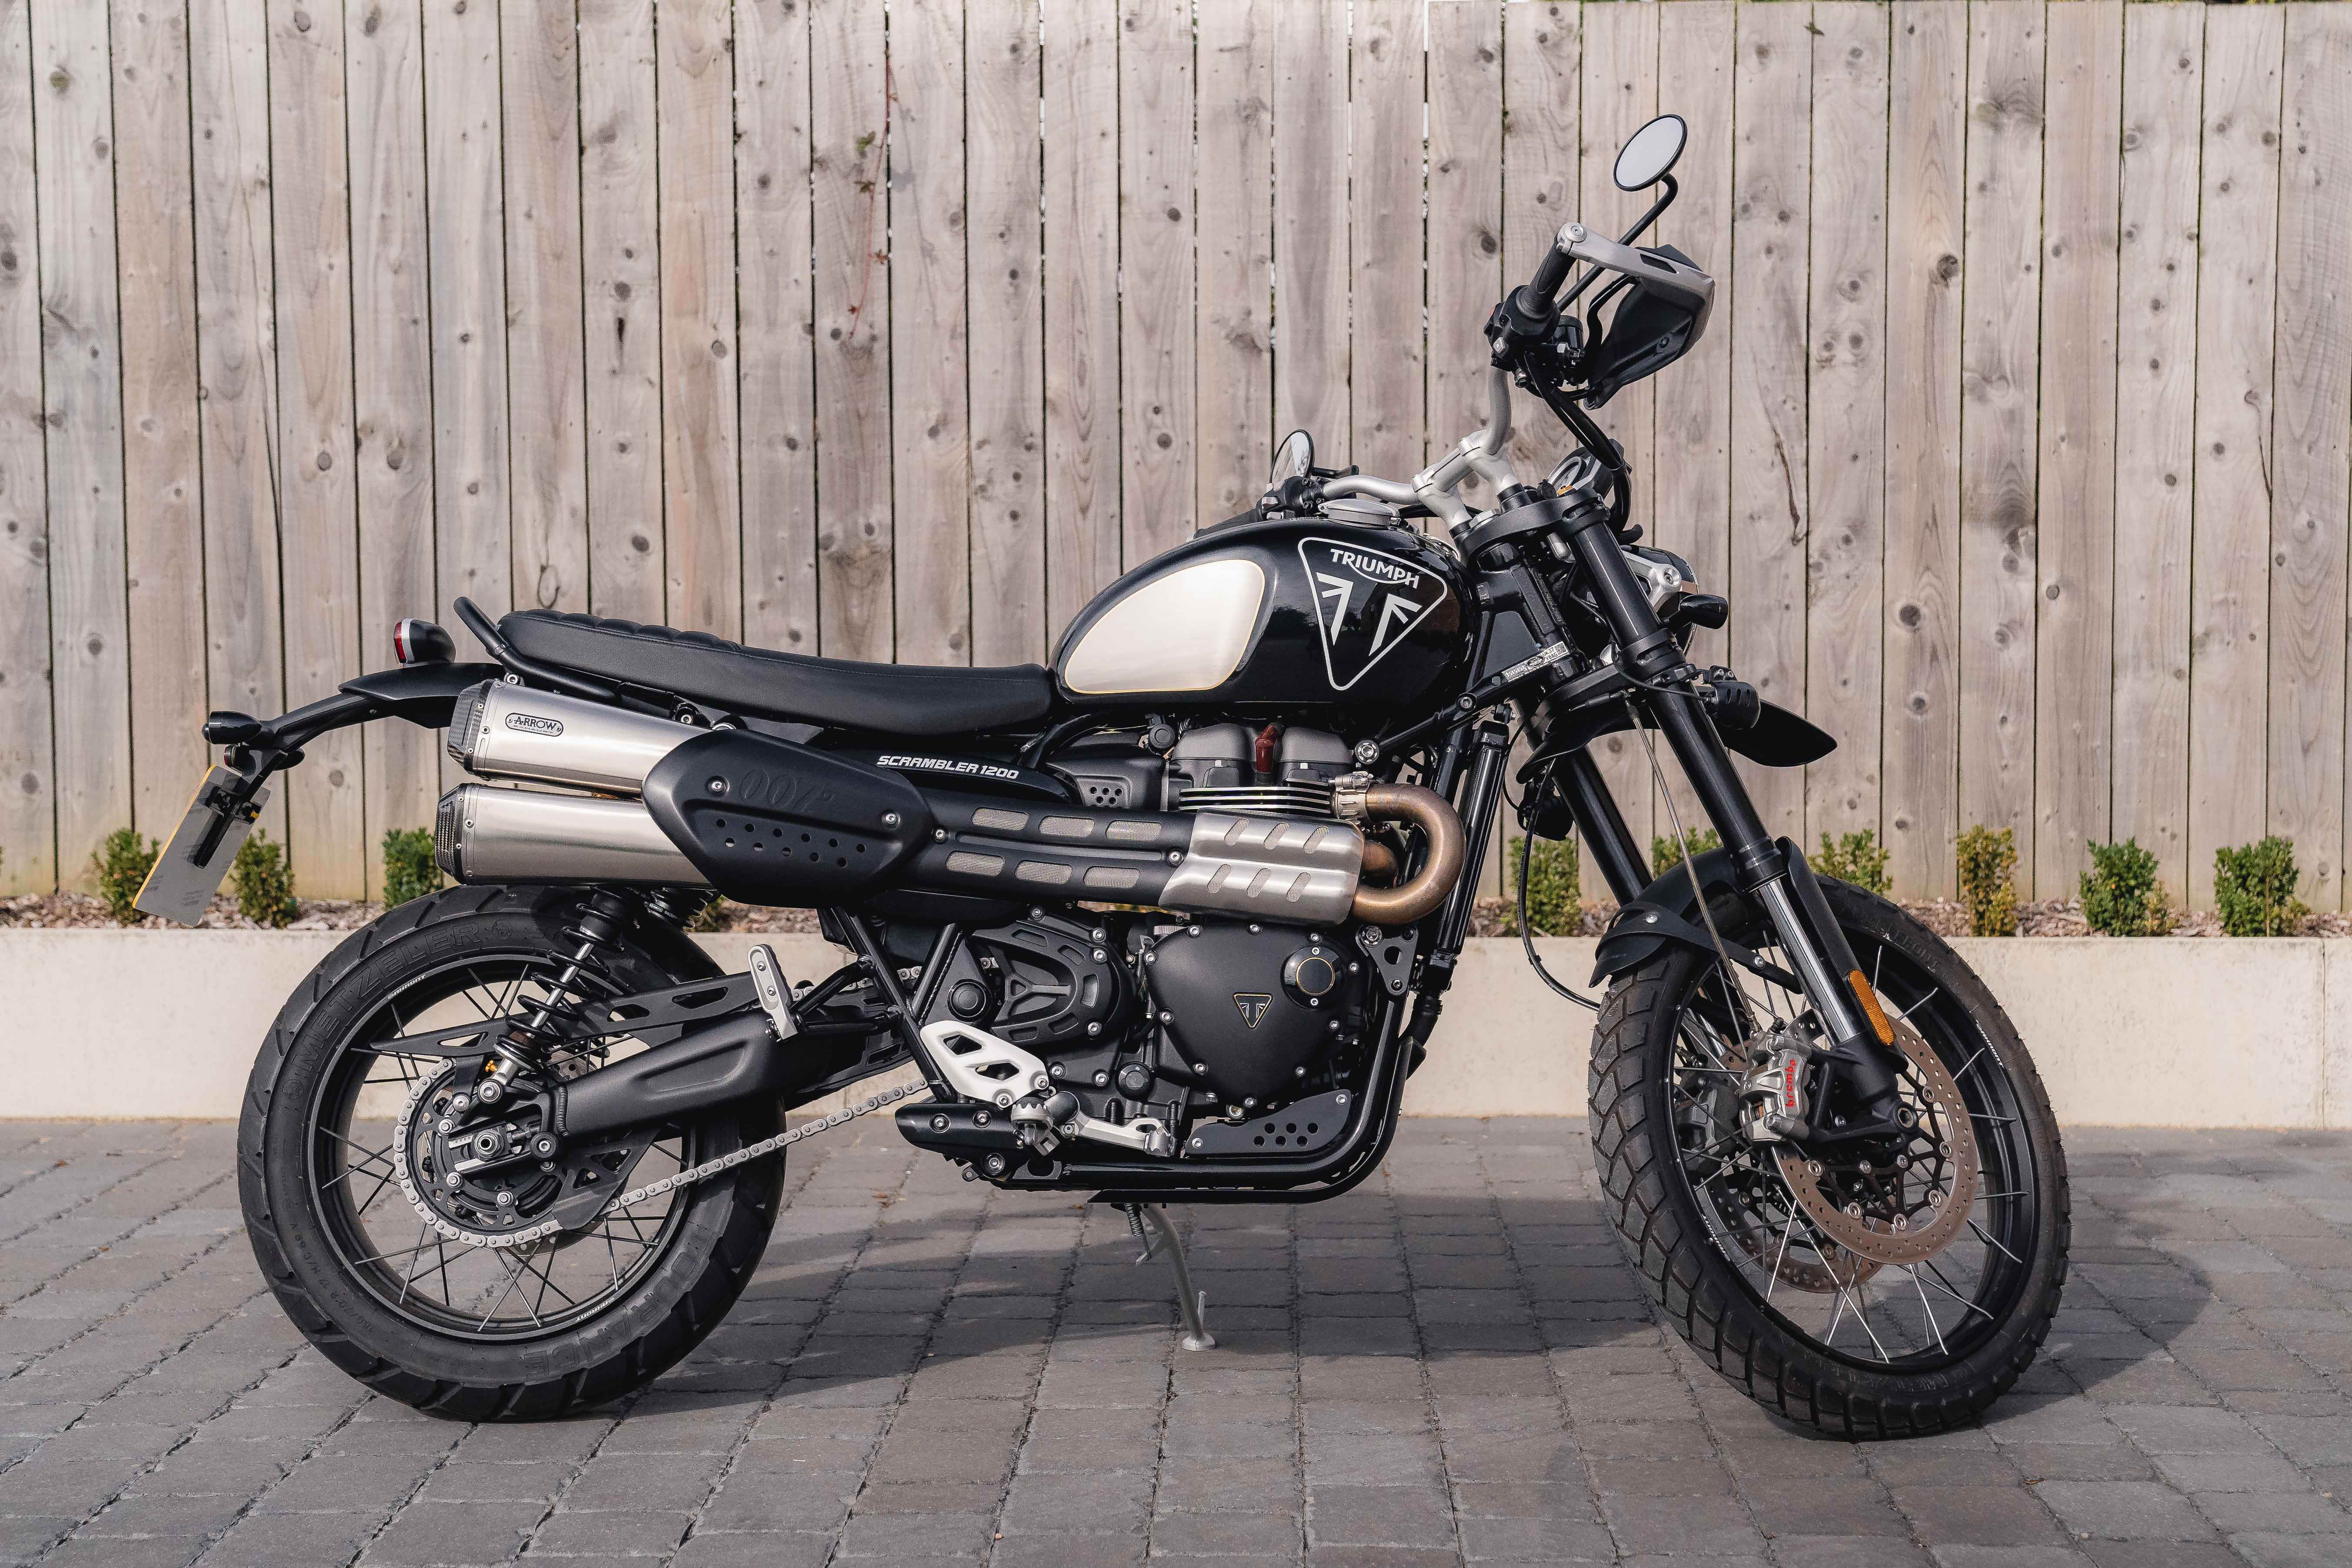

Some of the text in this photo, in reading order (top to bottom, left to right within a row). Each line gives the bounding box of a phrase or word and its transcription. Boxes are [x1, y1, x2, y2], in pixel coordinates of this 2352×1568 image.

[1330, 549, 1420, 589] TRIUMPH
[514, 716, 557, 731] ARROW
[877, 756, 1019, 779] SCRAMBLER 1200
[291, 921, 480, 1073] METZELER
[1785, 1059, 1796, 1107] brembo
[523, 1231, 719, 1379] TOURANCE
